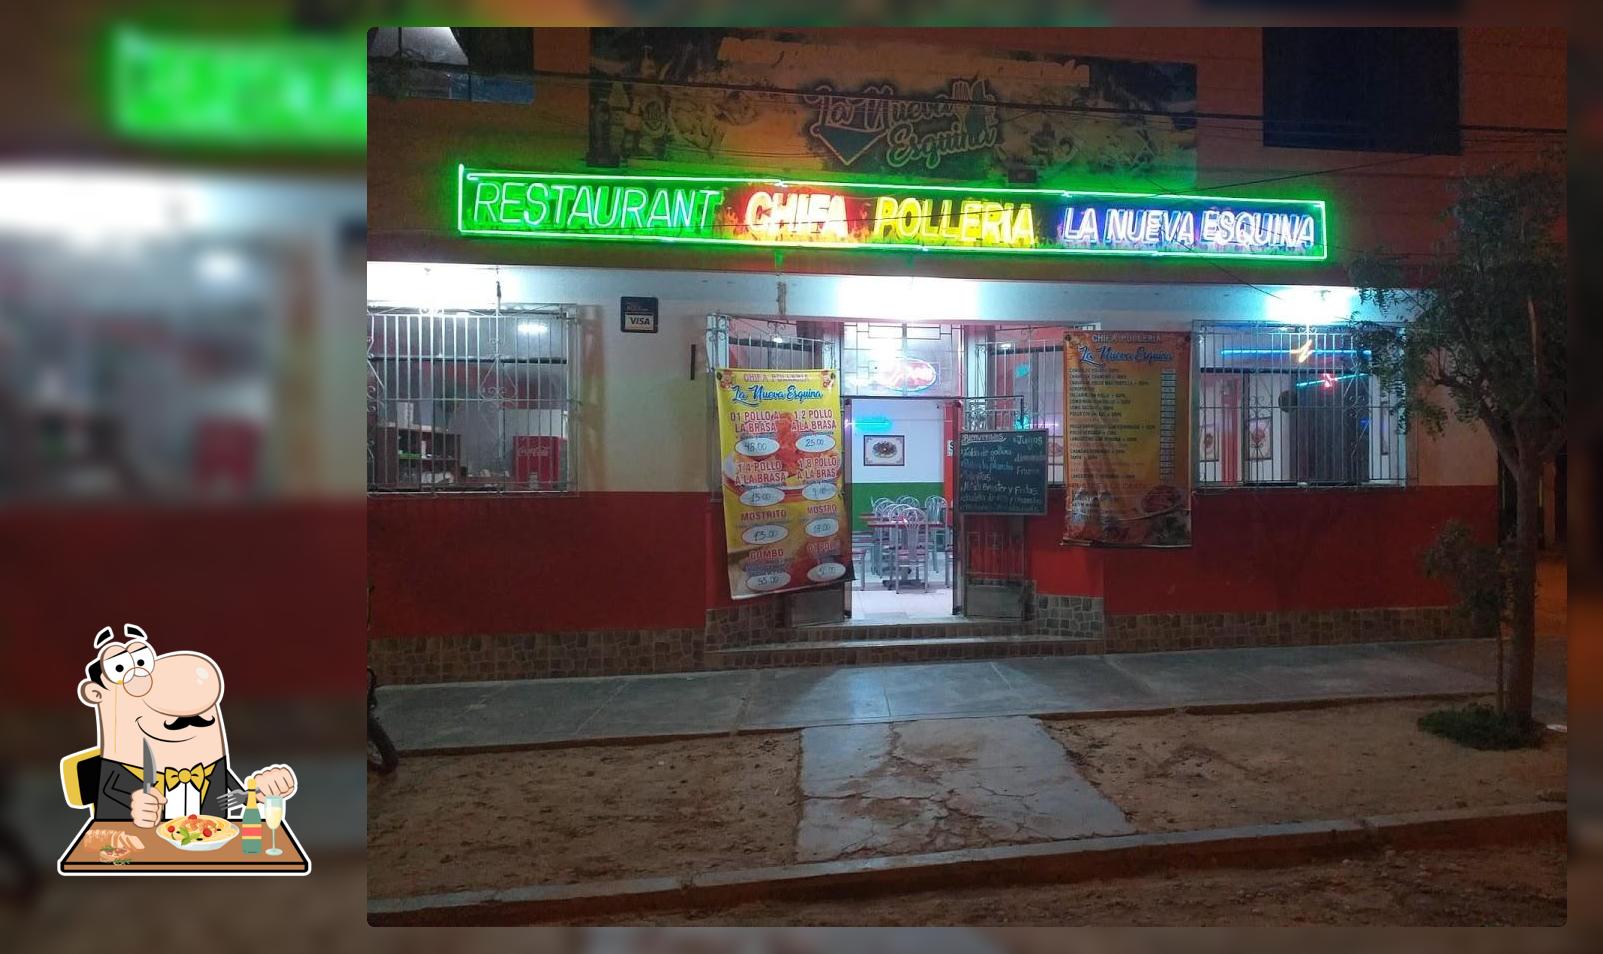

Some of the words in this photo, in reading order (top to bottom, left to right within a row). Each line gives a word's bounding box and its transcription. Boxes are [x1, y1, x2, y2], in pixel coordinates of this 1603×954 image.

[472, 182, 722, 230] RESTAURANT
[744, 190, 850, 238] CHIFA
[873, 195, 1036, 244] POLLERIA
[1061, 206, 1098, 243] LA
[1104, 208, 1194, 246] NUEVA
[1200, 209, 1317, 248] ESQUINA
[629, 316, 651, 326] VISA
[748, 384, 786, 401] Nueva
[786, 384, 823, 404] Esquina
[744, 411, 771, 421] POLLO
[808, 409, 833, 419] POLLO
[748, 421, 777, 432] BRASA
[811, 419, 836, 430] BRASA
[754, 461, 781, 471] POLLO
[815, 456, 837, 467] POLLO
[757, 471, 785, 483] BRASA
[807, 502, 838, 514] MOSTRO
[741, 509, 787, 521] MOSTRITO
